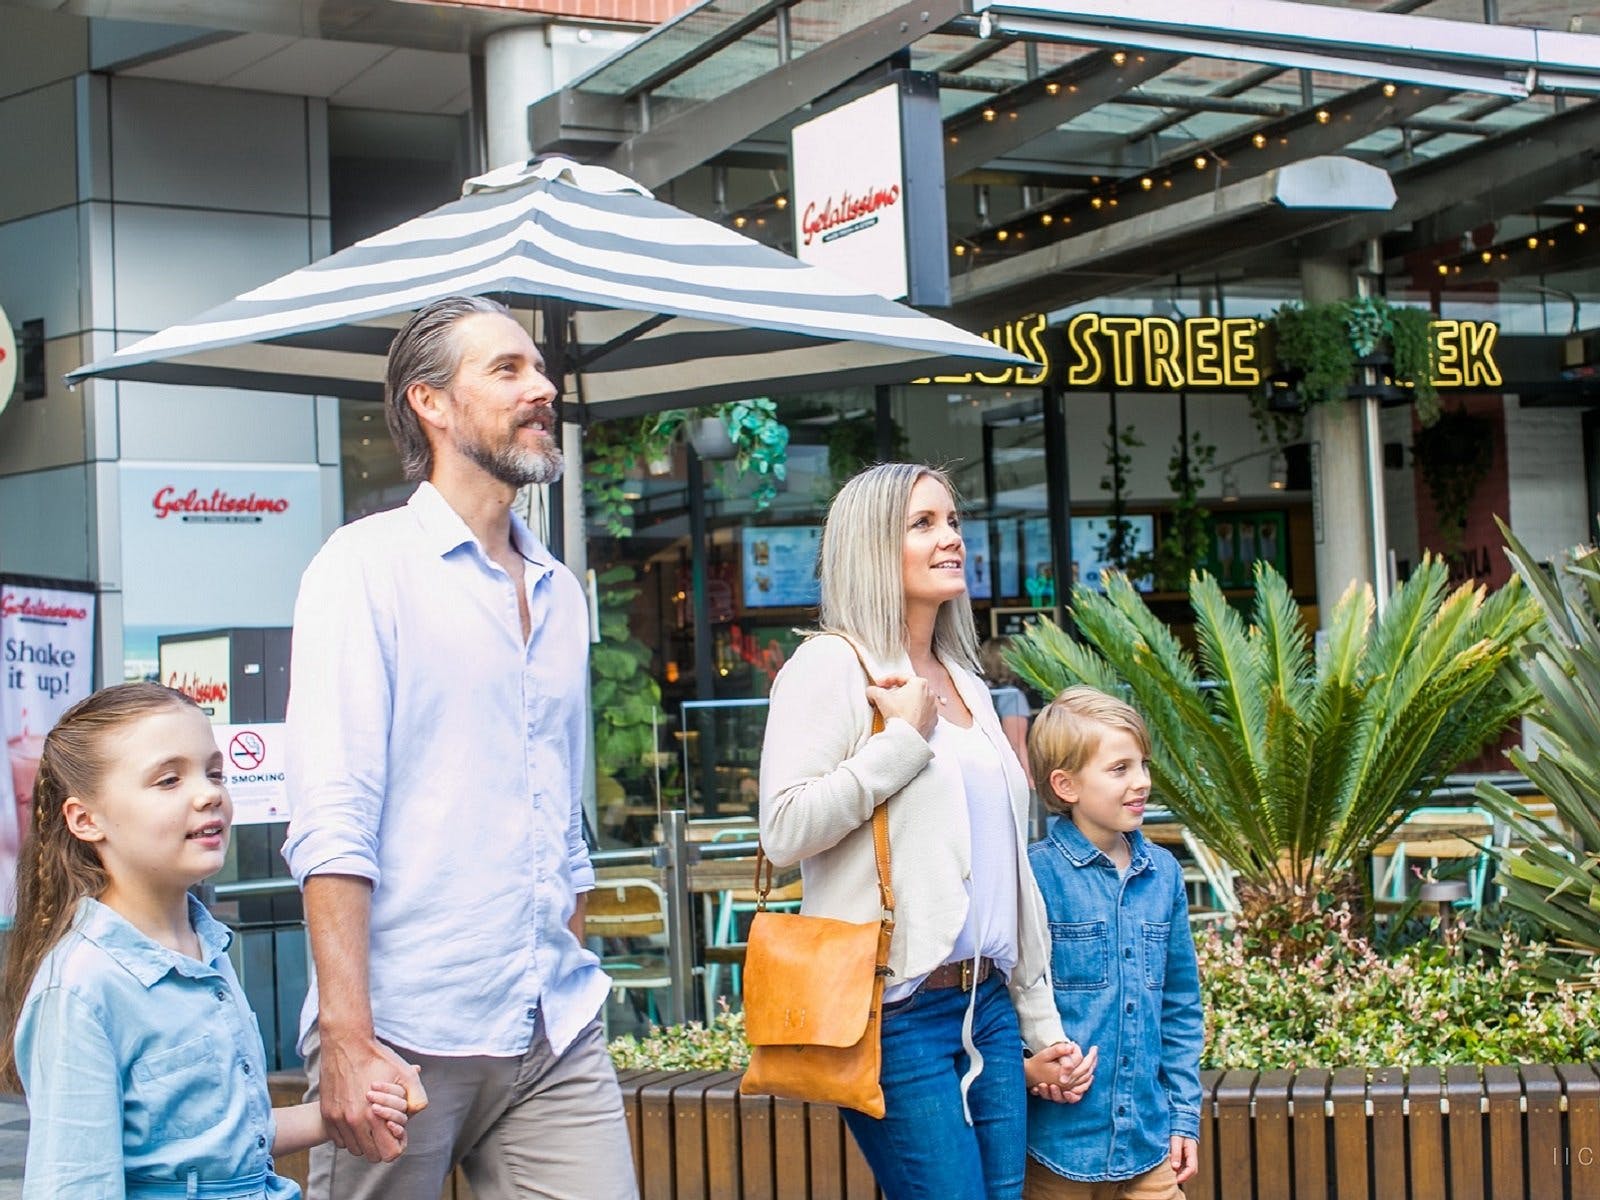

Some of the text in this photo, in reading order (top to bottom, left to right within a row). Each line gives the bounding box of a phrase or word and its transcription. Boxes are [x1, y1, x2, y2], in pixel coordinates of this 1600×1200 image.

[802, 184, 899, 246] Gelatissimo
[1068, 312, 1290, 388] STREE
[152, 485, 289, 519] Gelatissimo
[0, 593, 87, 620] Gelatissimo
[5, 637, 76, 668] Shake
[8, 666, 70, 699] it up!
[231, 773, 285, 785] SMOKING
